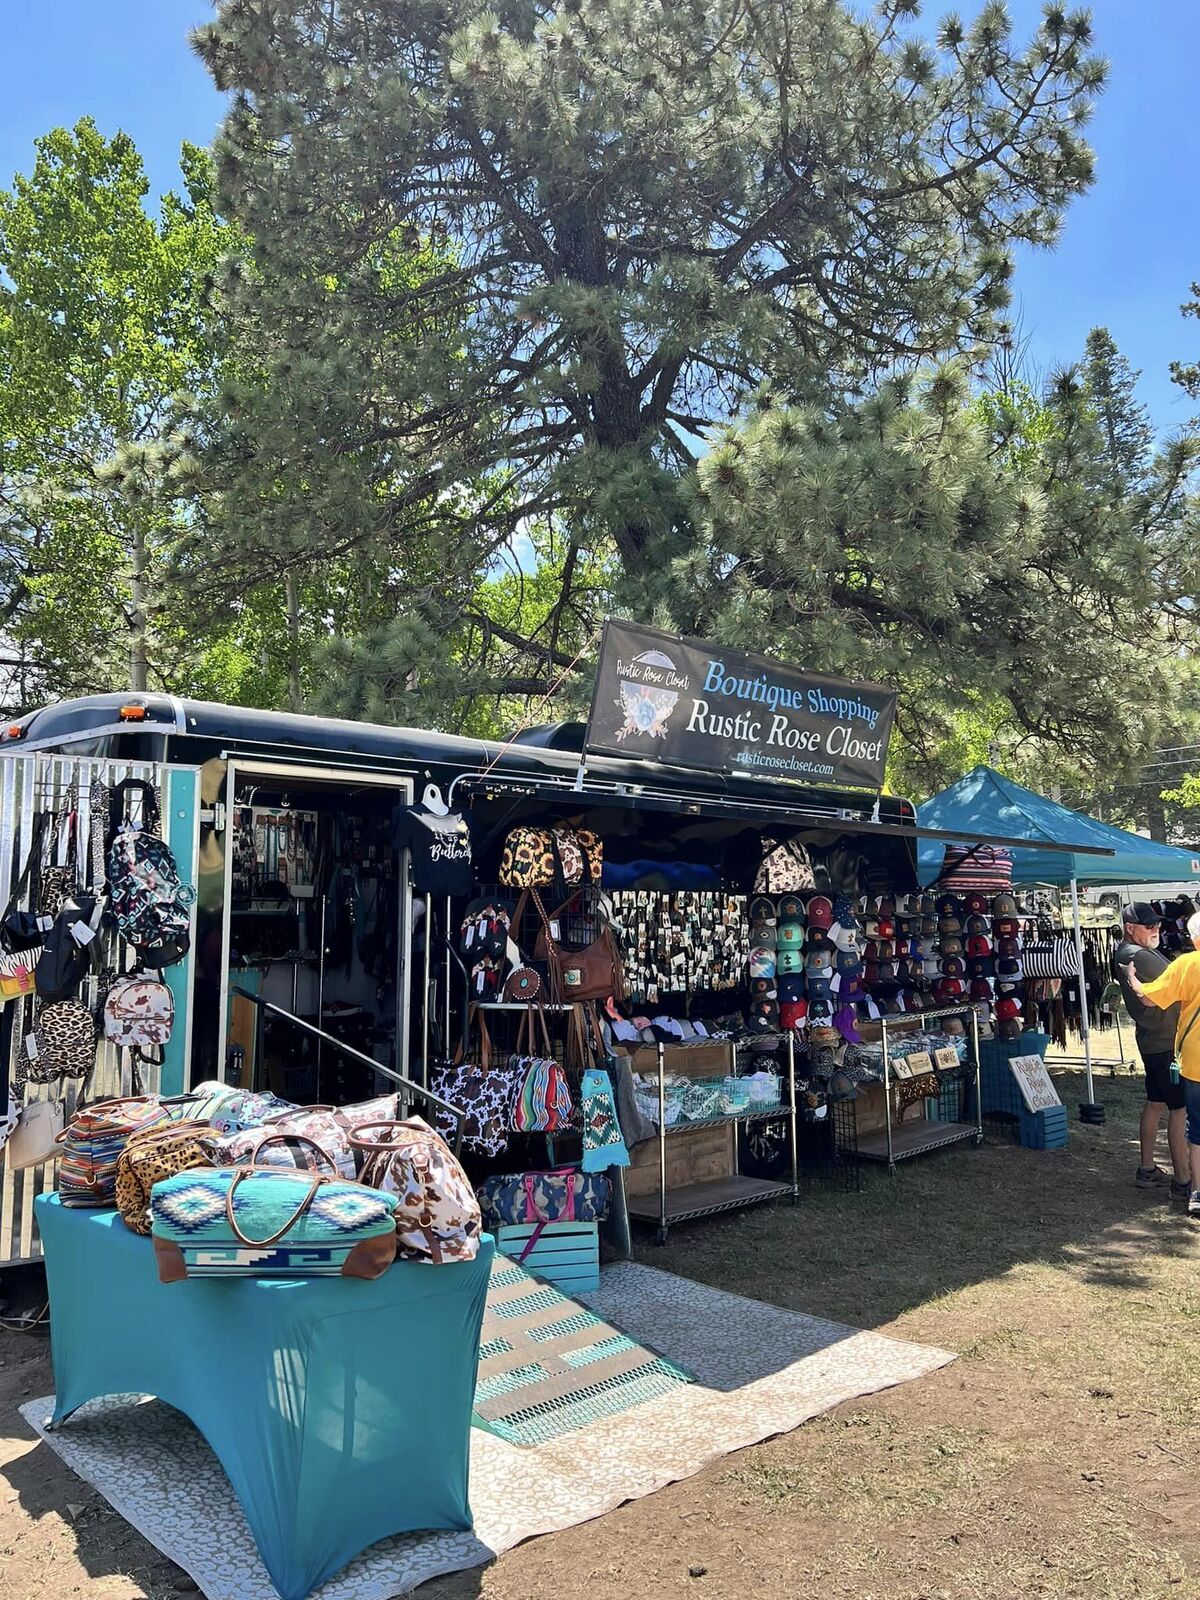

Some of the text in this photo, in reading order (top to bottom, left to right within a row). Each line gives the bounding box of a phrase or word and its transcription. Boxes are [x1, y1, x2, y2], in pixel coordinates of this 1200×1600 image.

[616, 659, 690, 691] Rustic Rose Closet
[703, 660, 879, 730] Boutique Shopping
[685, 698, 882, 761] Rustic Rose Closet
[736, 751, 834, 775] rusticrosecloset.com
